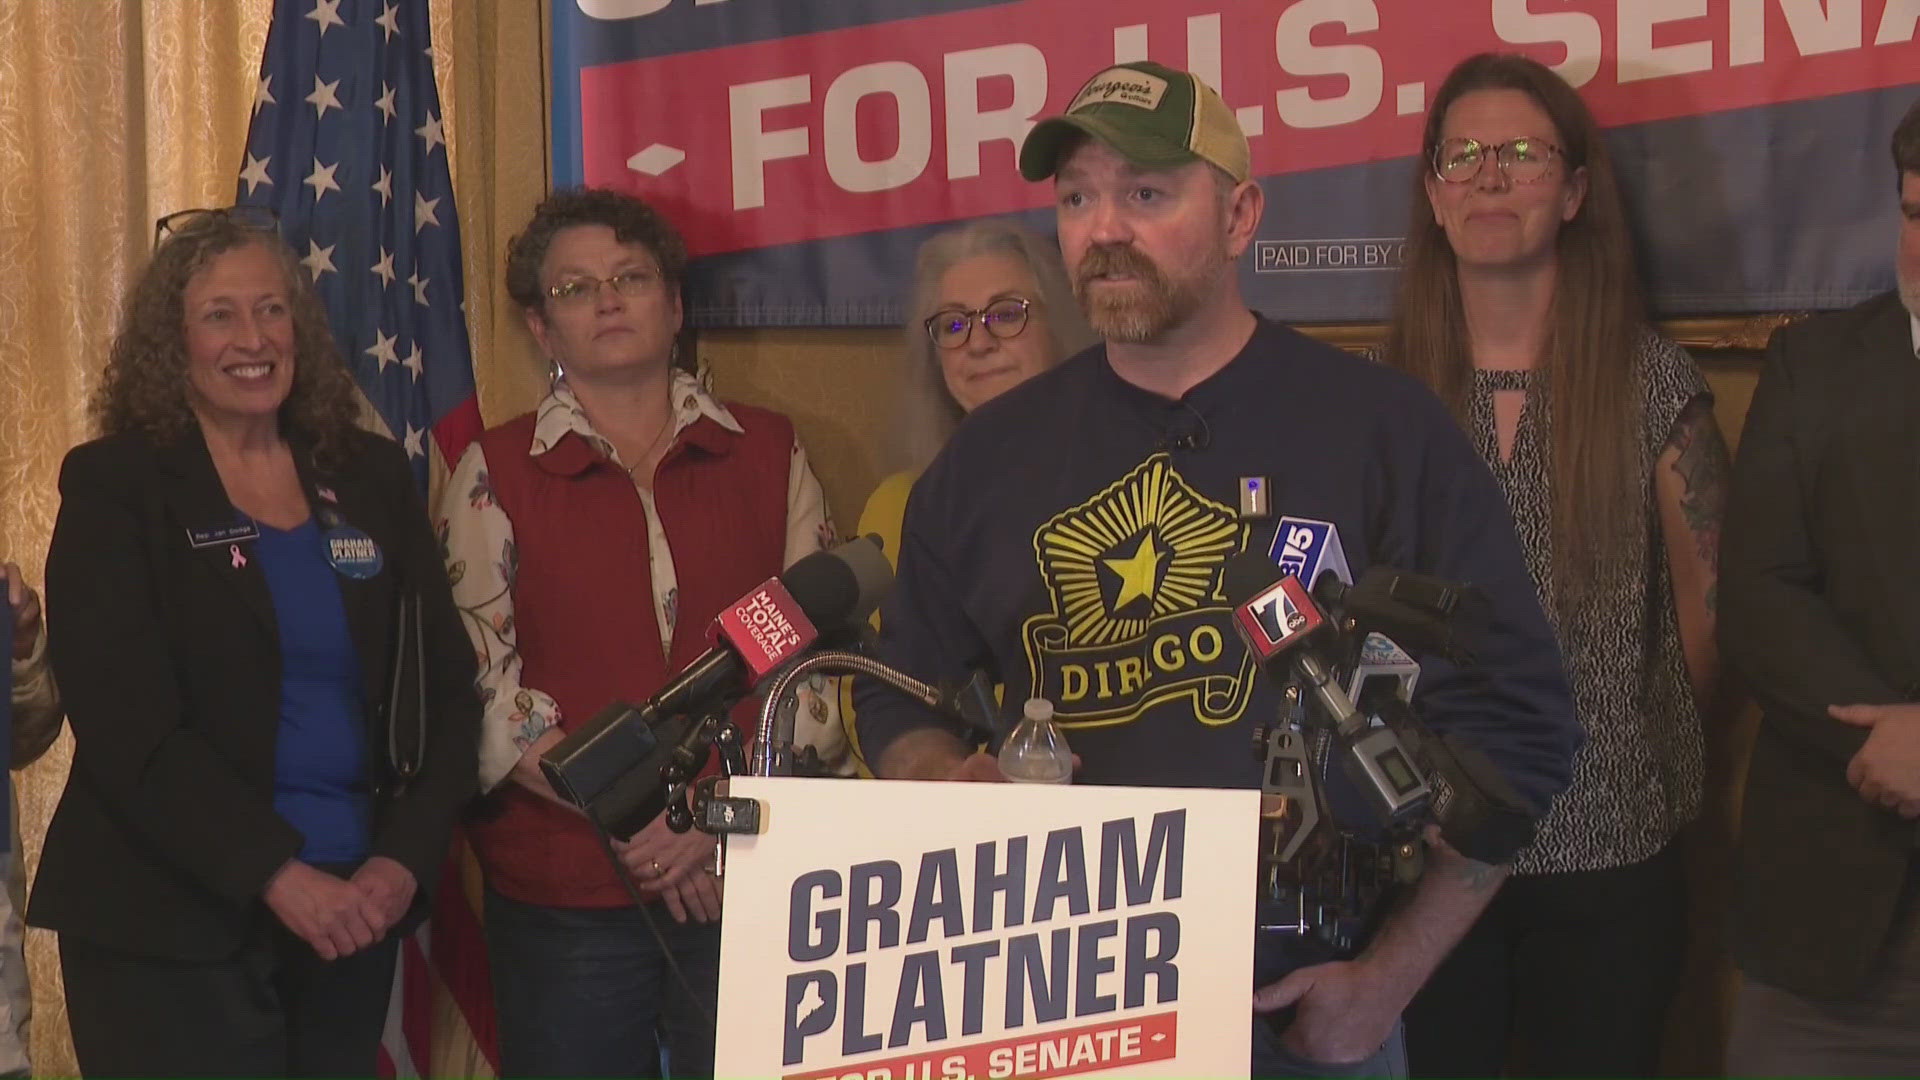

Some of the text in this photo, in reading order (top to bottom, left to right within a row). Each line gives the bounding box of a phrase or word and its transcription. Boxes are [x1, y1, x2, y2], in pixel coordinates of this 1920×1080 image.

[728, 42, 1049, 211] FOR
[1262, 246, 1310, 267] PAID
[1316, 245, 1358, 266] FOR
[1364, 244, 1392, 265] BY
[330, 538, 374, 549] GRAHAM
[735, 606, 779, 662] COVERAGE
[745, 598, 789, 655] TOTAL
[755, 590, 800, 646] MAINE'S
[1248, 585, 1298, 643] 7
[1061, 625, 1223, 701] DIRGO
[787, 808, 1187, 963] GRAHAM
[782, 911, 1181, 1066] PLATNER
[988, 1025, 1142, 1078] SENATE
